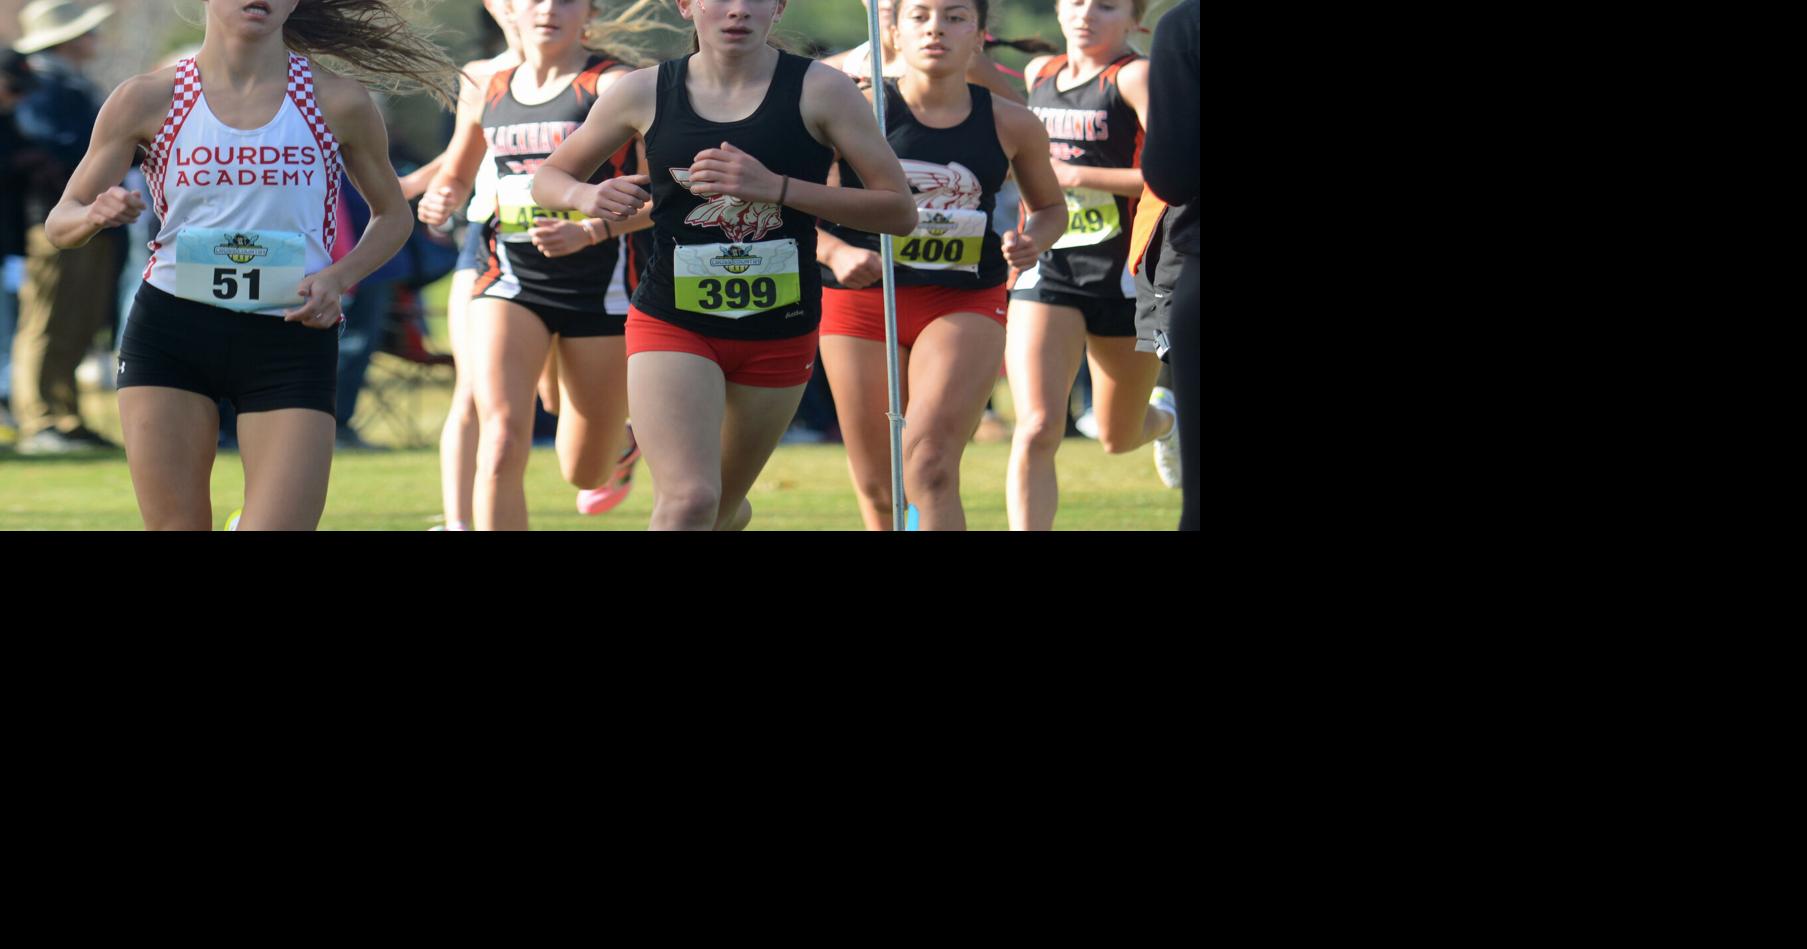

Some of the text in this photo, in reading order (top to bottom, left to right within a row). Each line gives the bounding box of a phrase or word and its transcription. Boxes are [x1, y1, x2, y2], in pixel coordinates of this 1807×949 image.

[176, 146, 315, 166] LOURDES
[176, 169, 315, 186] ACADEMY
[1070, 208, 1104, 233] 49
[899, 238, 964, 262] 400
[212, 267, 261, 301] 51
[698, 276, 777, 310] 399
